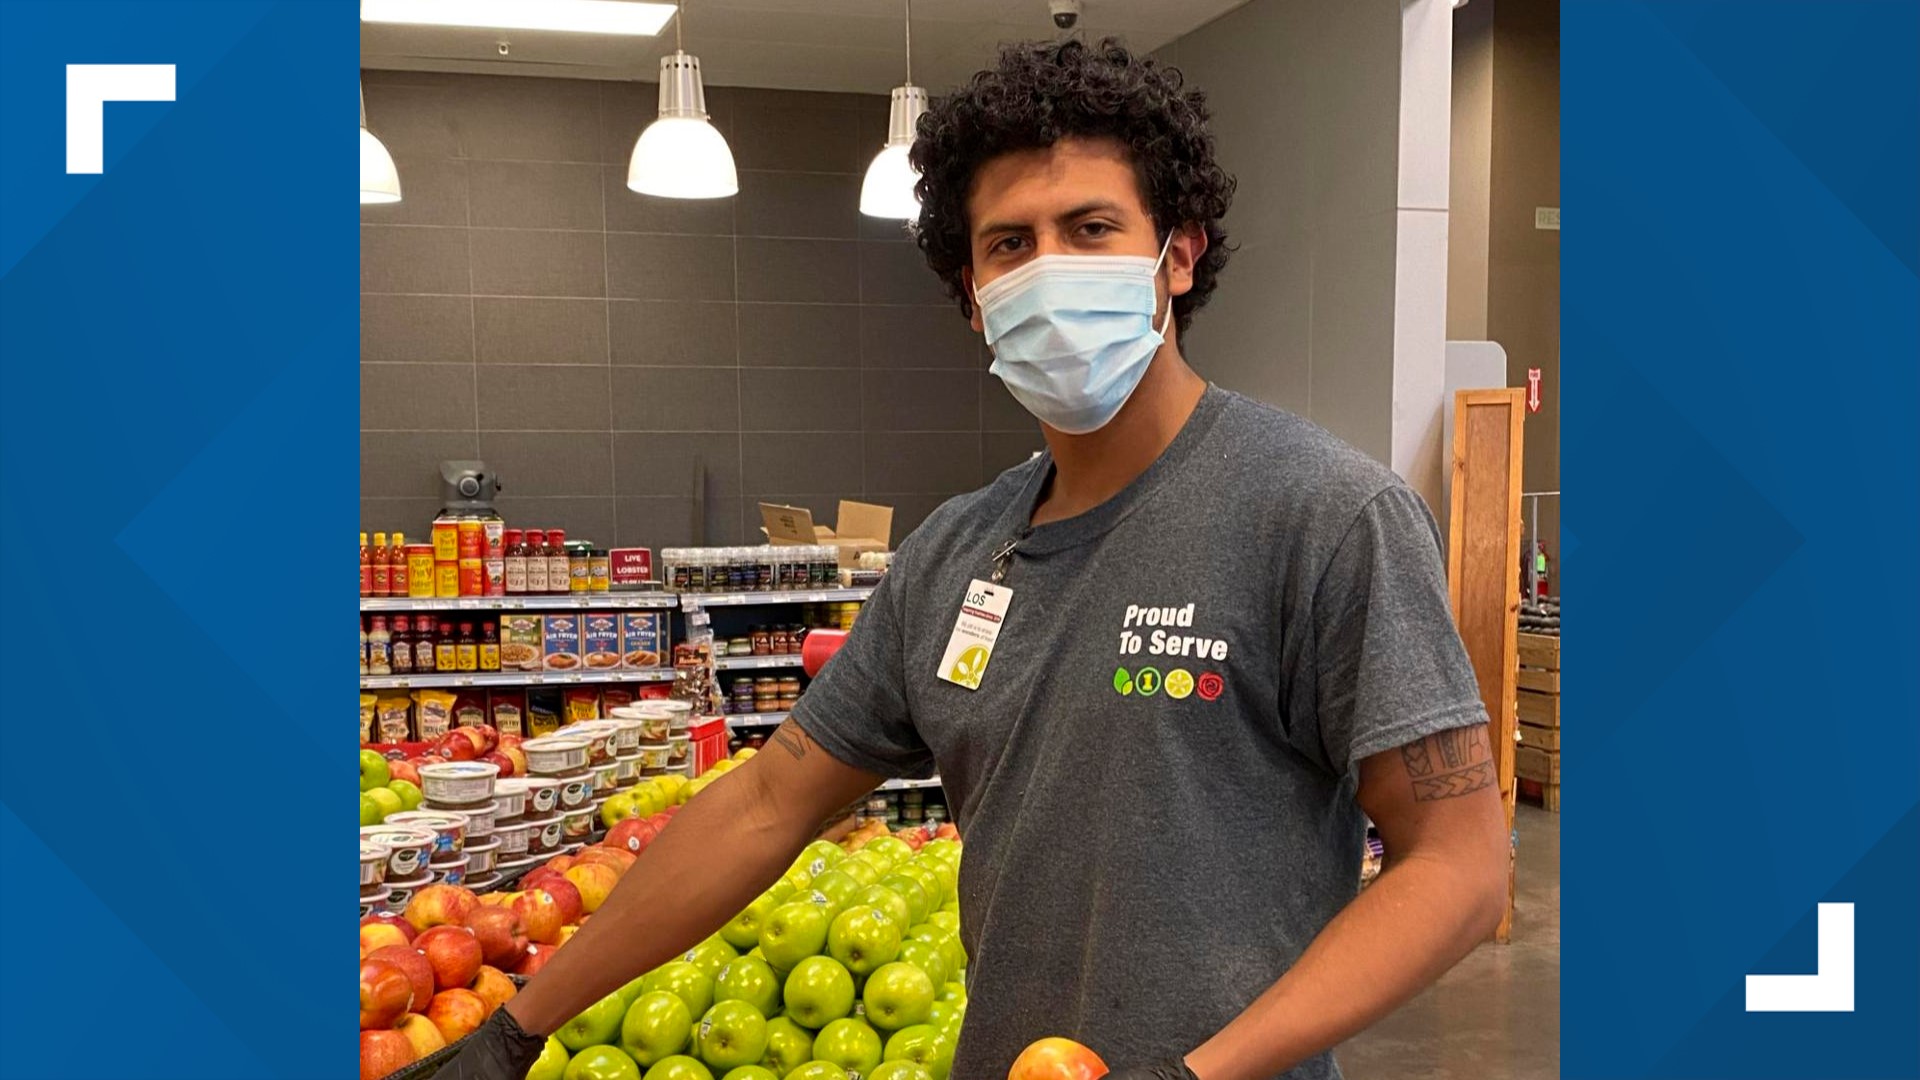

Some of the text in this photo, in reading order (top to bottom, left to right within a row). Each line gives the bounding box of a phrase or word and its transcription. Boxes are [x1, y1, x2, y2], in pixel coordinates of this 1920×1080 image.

[624, 554, 641, 563] LIVE
[966, 591, 986, 606] LOS
[1123, 603, 1195, 628] Proud
[1119, 629, 1229, 660] To Serve
